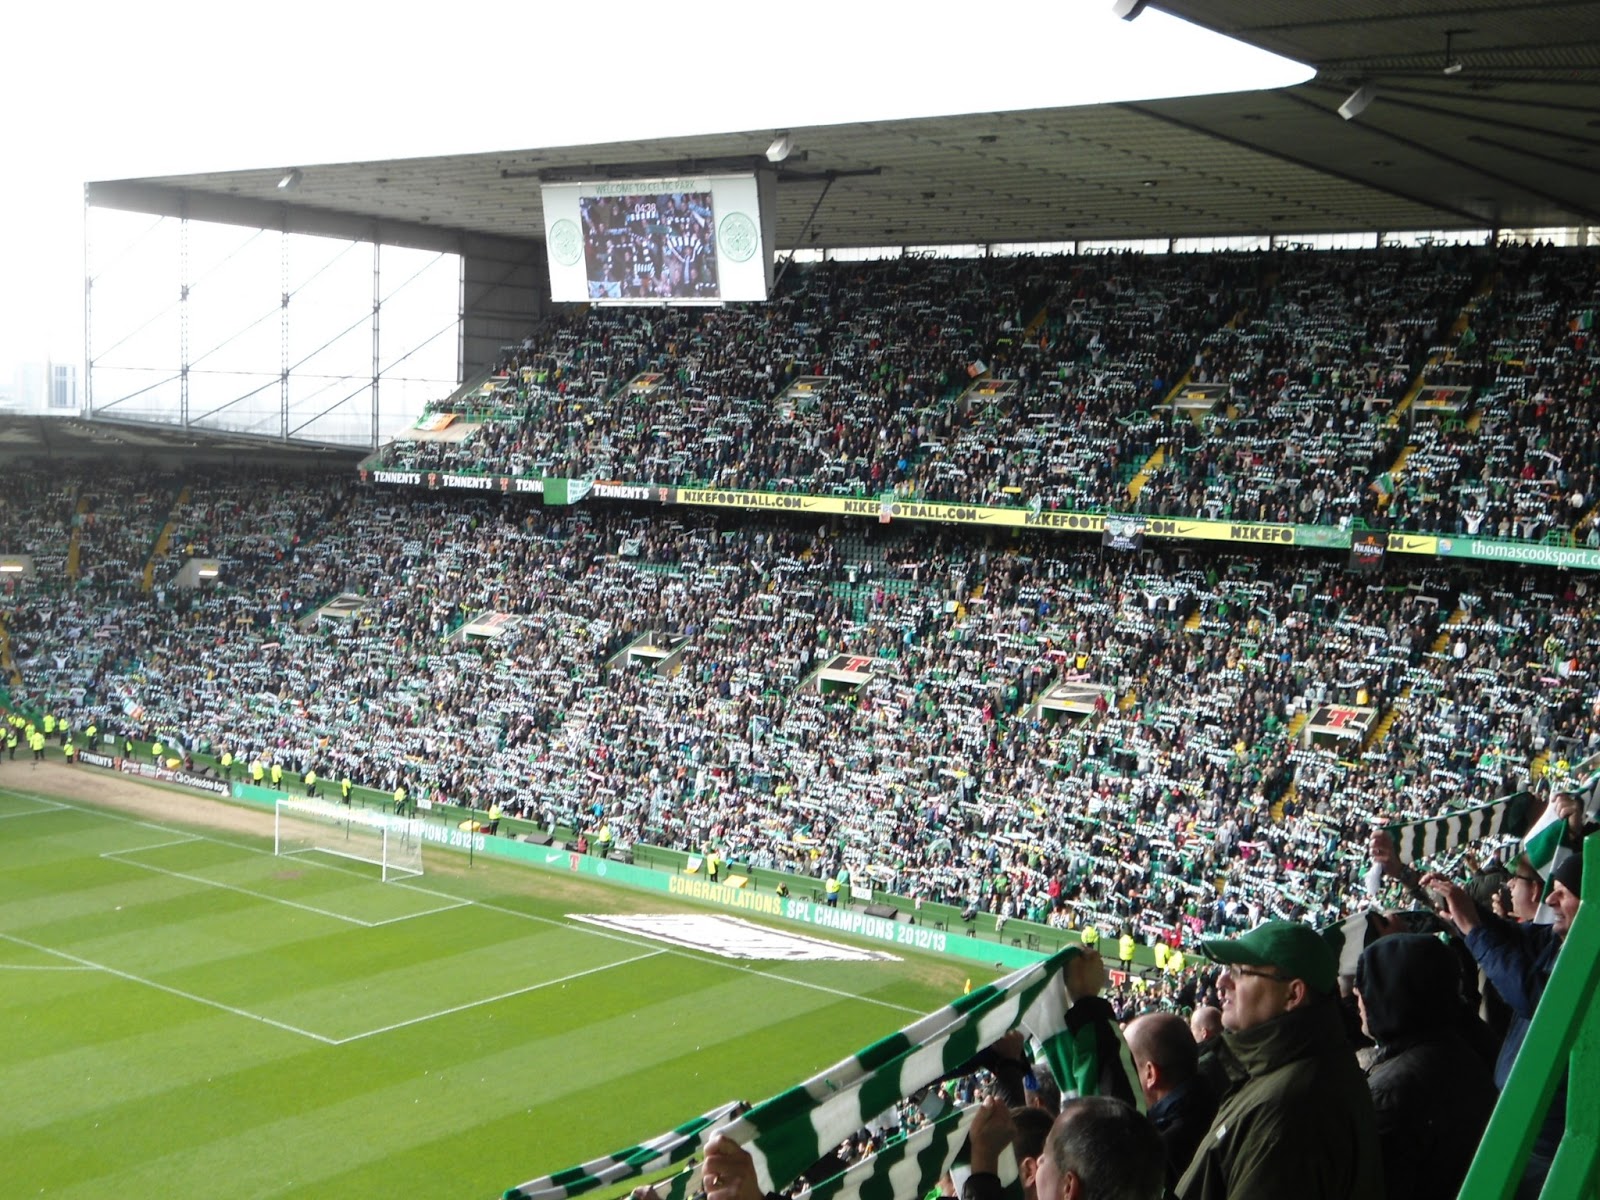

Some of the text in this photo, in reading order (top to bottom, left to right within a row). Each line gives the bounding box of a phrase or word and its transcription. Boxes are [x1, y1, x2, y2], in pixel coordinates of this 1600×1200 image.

[596, 181, 695, 194] WELCOME TO CELTIC PARK
[374, 471, 421, 485] TENNENT'S
[442, 474, 493, 490] TENNENT'S
[593, 484, 650, 499] TENNENT'S
[684, 490, 802, 509] NIKEFOOTBALL.COM
[844, 500, 976, 521] NIKEFOTBALL.COM
[1326, 709, 1358, 729] T
[450, 831, 485, 851] 2012/13
[786, 901, 810, 922] SPL
[814, 907, 894, 941] CHAMPIONS
[896, 926, 947, 952] 2012/13
[1109, 969, 1126, 988] T
